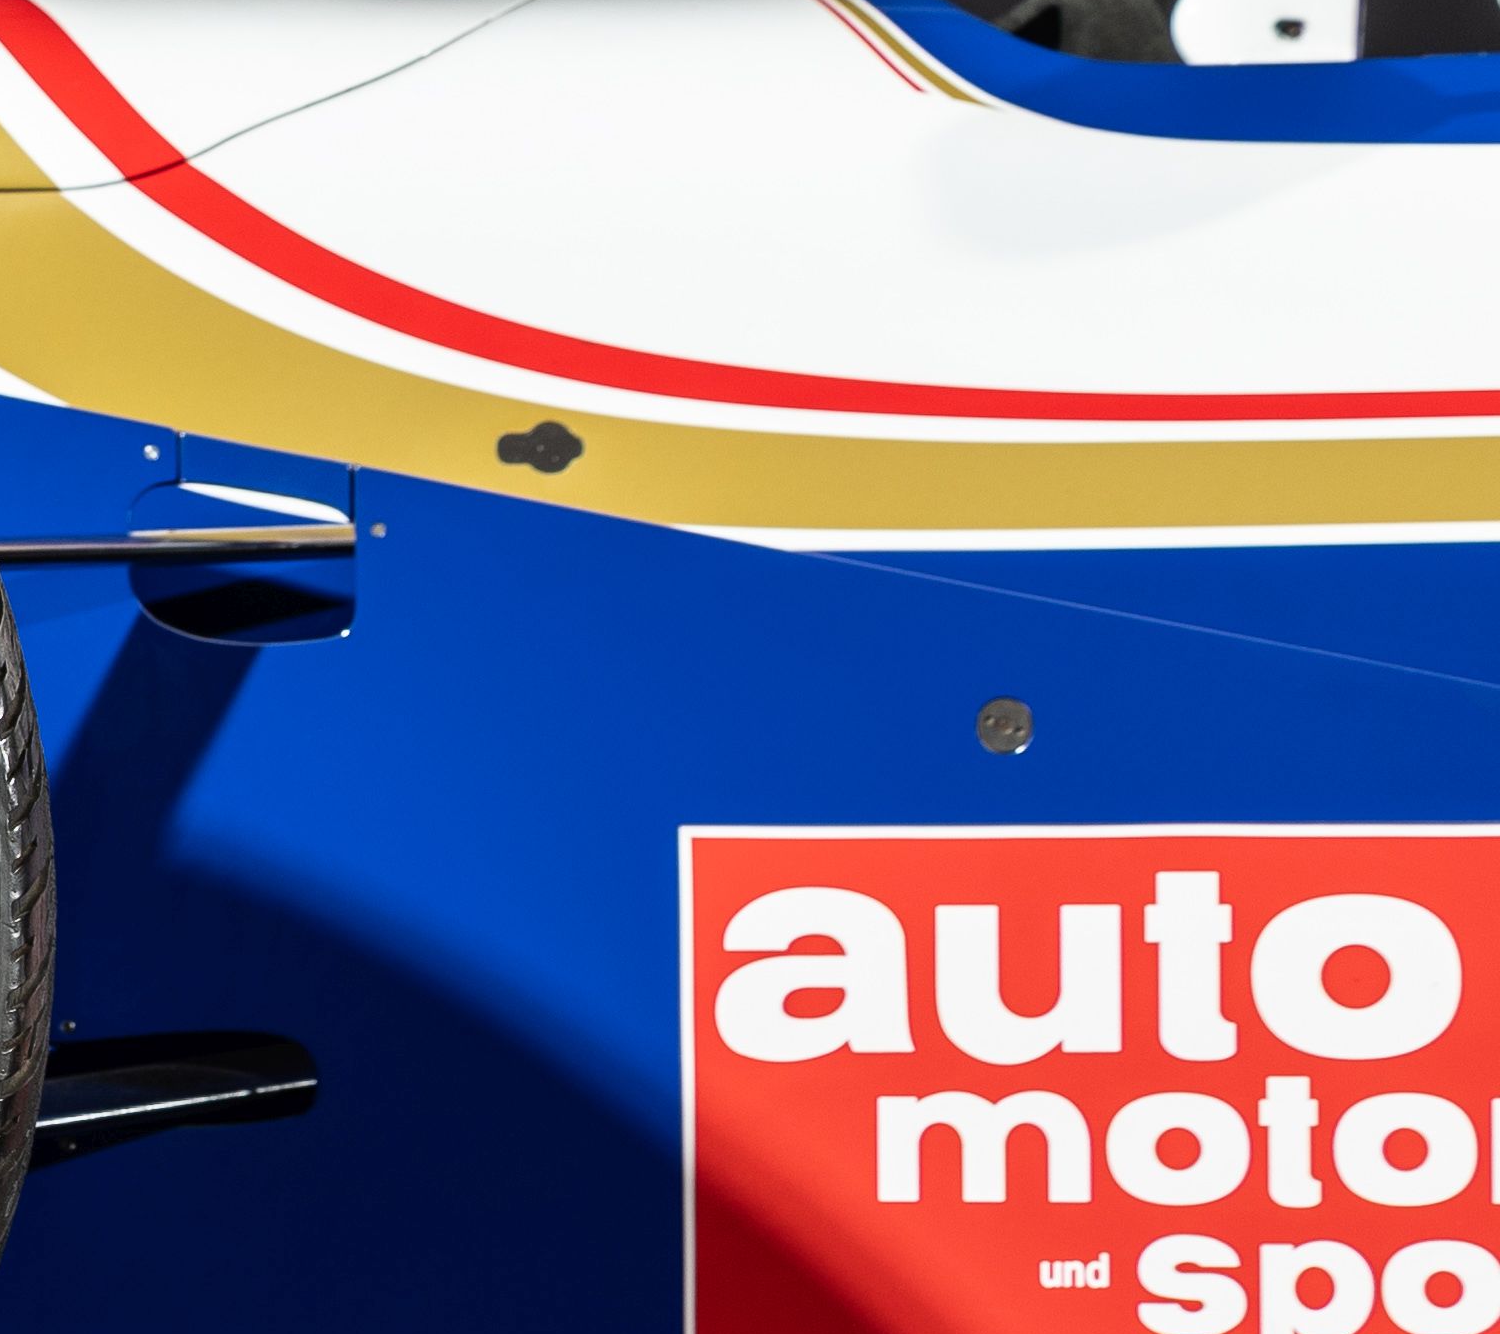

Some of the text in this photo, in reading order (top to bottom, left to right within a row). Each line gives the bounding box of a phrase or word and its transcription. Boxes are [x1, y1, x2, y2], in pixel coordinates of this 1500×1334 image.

[714, 870, 1463, 1066] auto
[876, 1075, 1500, 1210] moto
[1039, 1251, 1111, 1289] und
